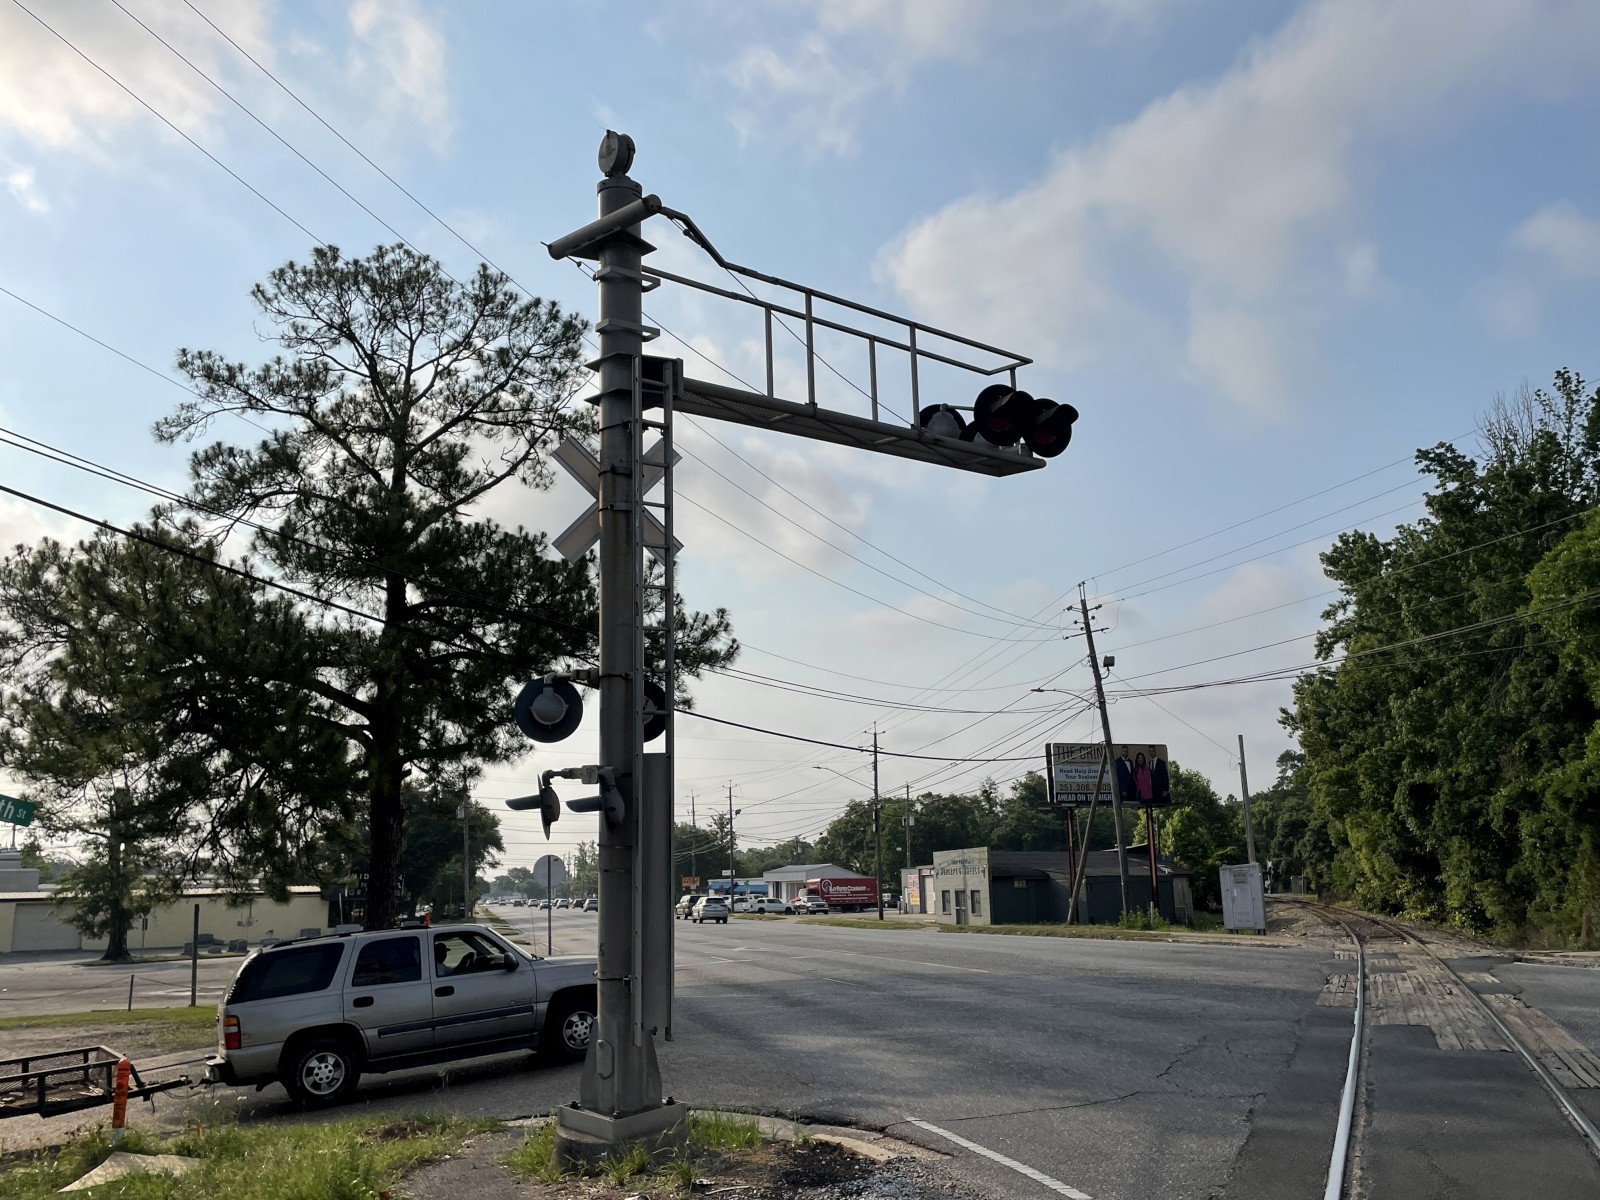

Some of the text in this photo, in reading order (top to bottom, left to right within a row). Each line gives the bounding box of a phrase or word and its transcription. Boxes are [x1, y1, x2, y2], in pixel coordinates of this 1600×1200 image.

[1055, 746, 1076, 760] THE
[1059, 783, 1112, 792] 251.206.703
[1057, 793, 1076, 802] AHEAD
[1077, 793, 1086, 802] ON
[17, 808, 26, 819] St
